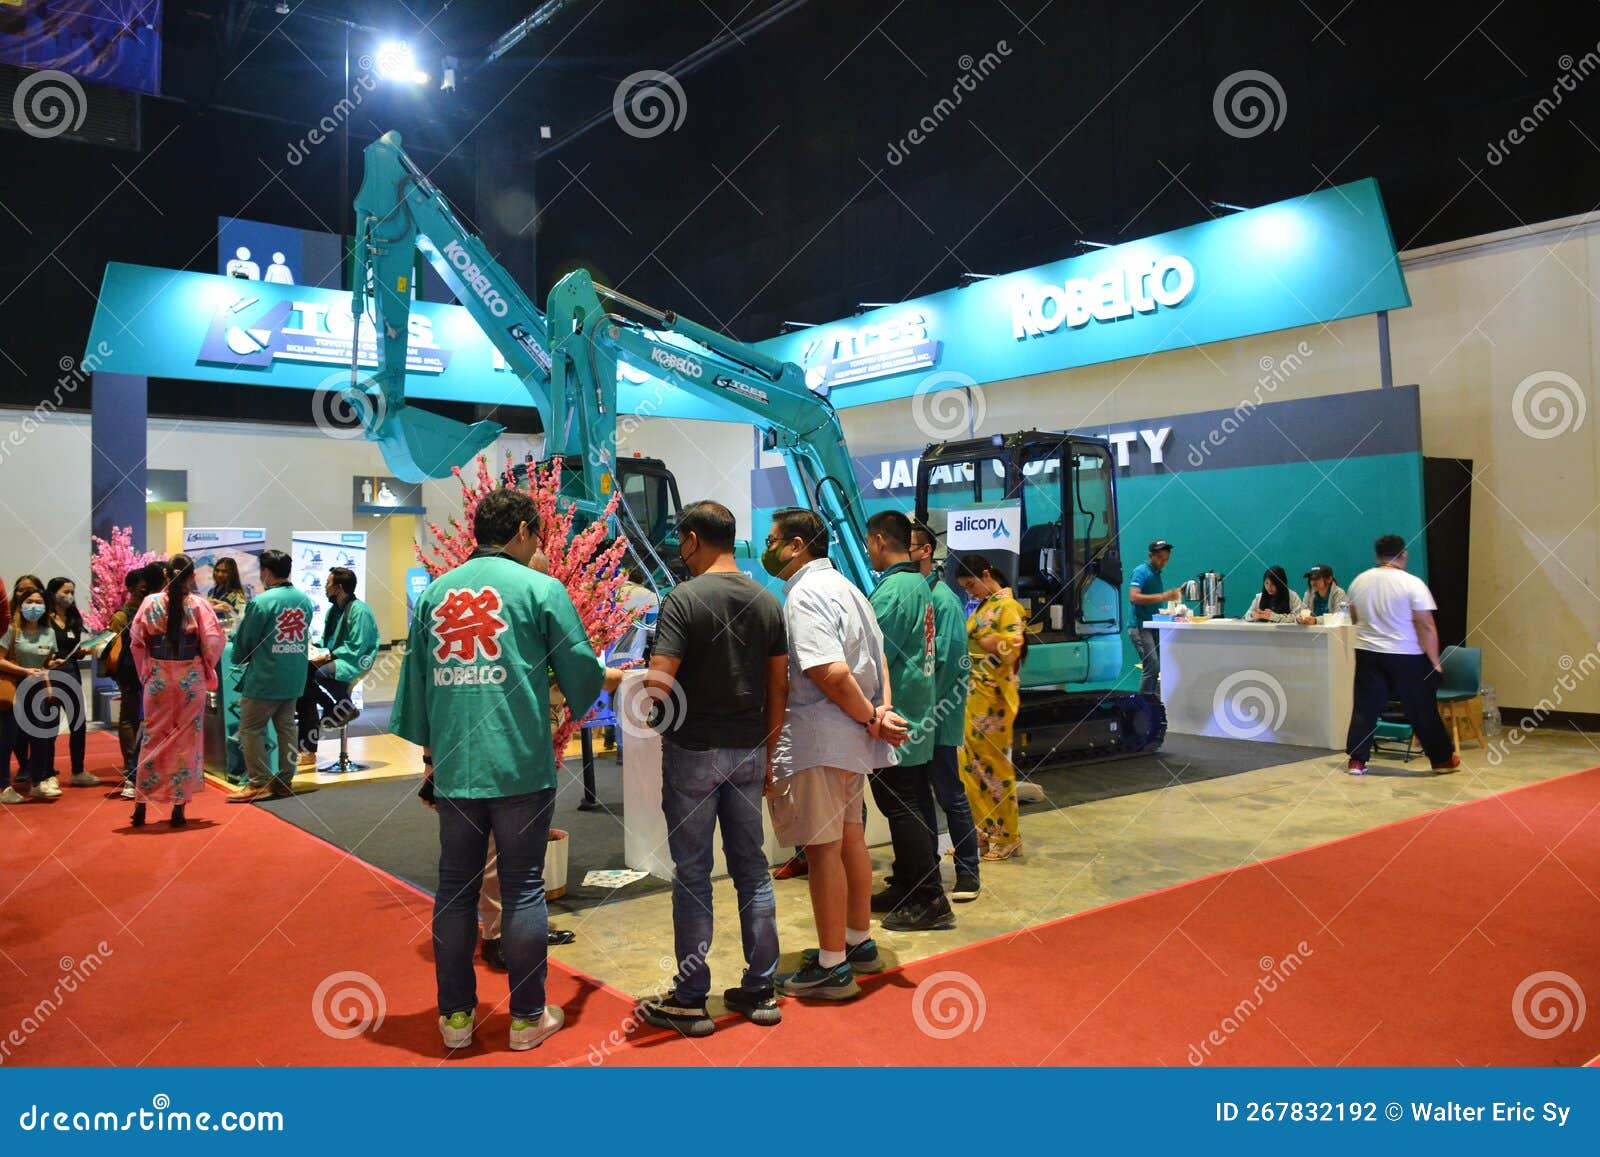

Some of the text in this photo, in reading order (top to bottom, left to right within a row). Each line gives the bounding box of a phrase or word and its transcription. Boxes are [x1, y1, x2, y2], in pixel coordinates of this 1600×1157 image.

[443, 239, 508, 317] KOBELCO
[1011, 254, 1195, 338] KOBELCO
[833, 313, 928, 358] TCES
[651, 346, 703, 378] KOBELCO
[954, 516, 997, 531] alicon
[275, 607, 307, 643] 祭
[431, 586, 509, 665] 祭
[433, 665, 507, 687] KOBELCO
